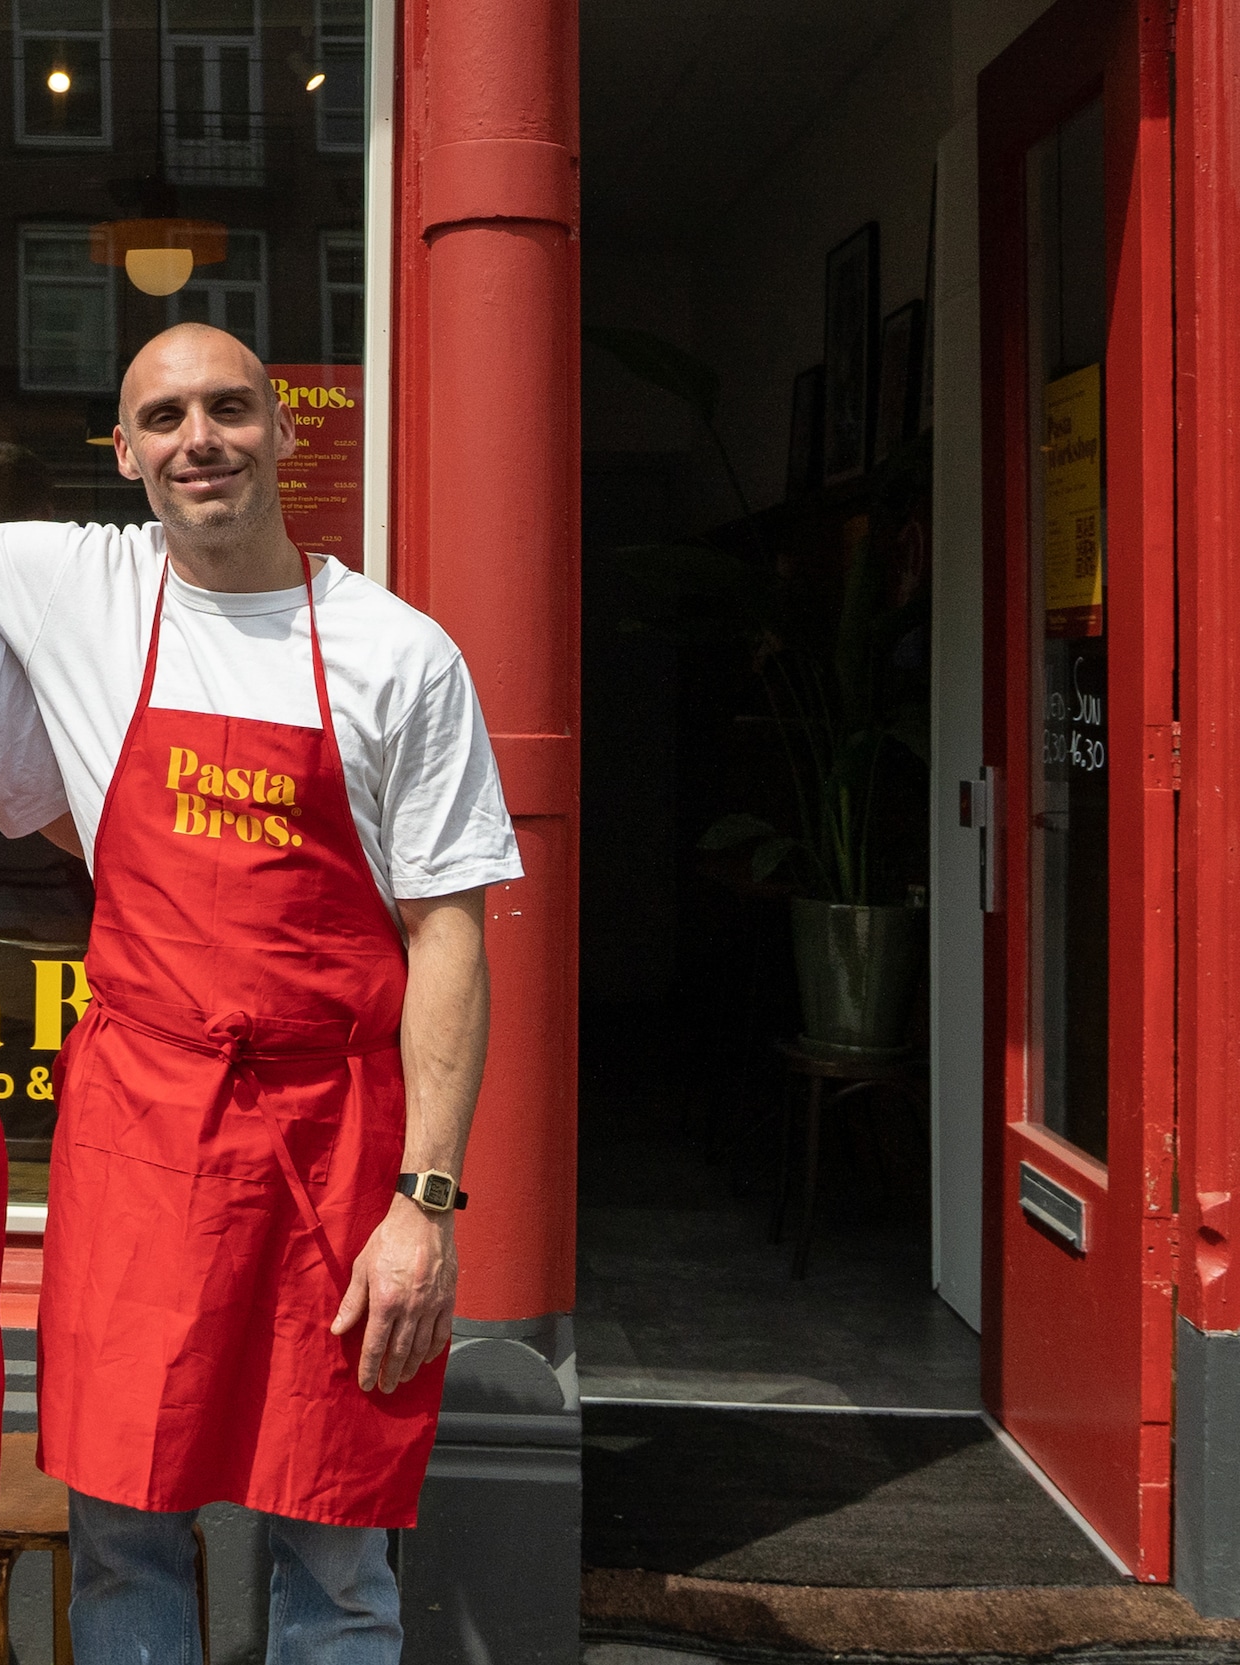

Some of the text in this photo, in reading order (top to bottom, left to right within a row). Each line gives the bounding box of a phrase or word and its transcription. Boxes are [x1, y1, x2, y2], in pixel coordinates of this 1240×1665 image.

[269, 379, 355, 409] Bros.
[295, 413, 325, 428] kery
[295, 438, 310, 447] ish
[290, 480, 307, 489] Box
[165, 746, 296, 806] Pasta
[172, 791, 303, 848] Bros.
